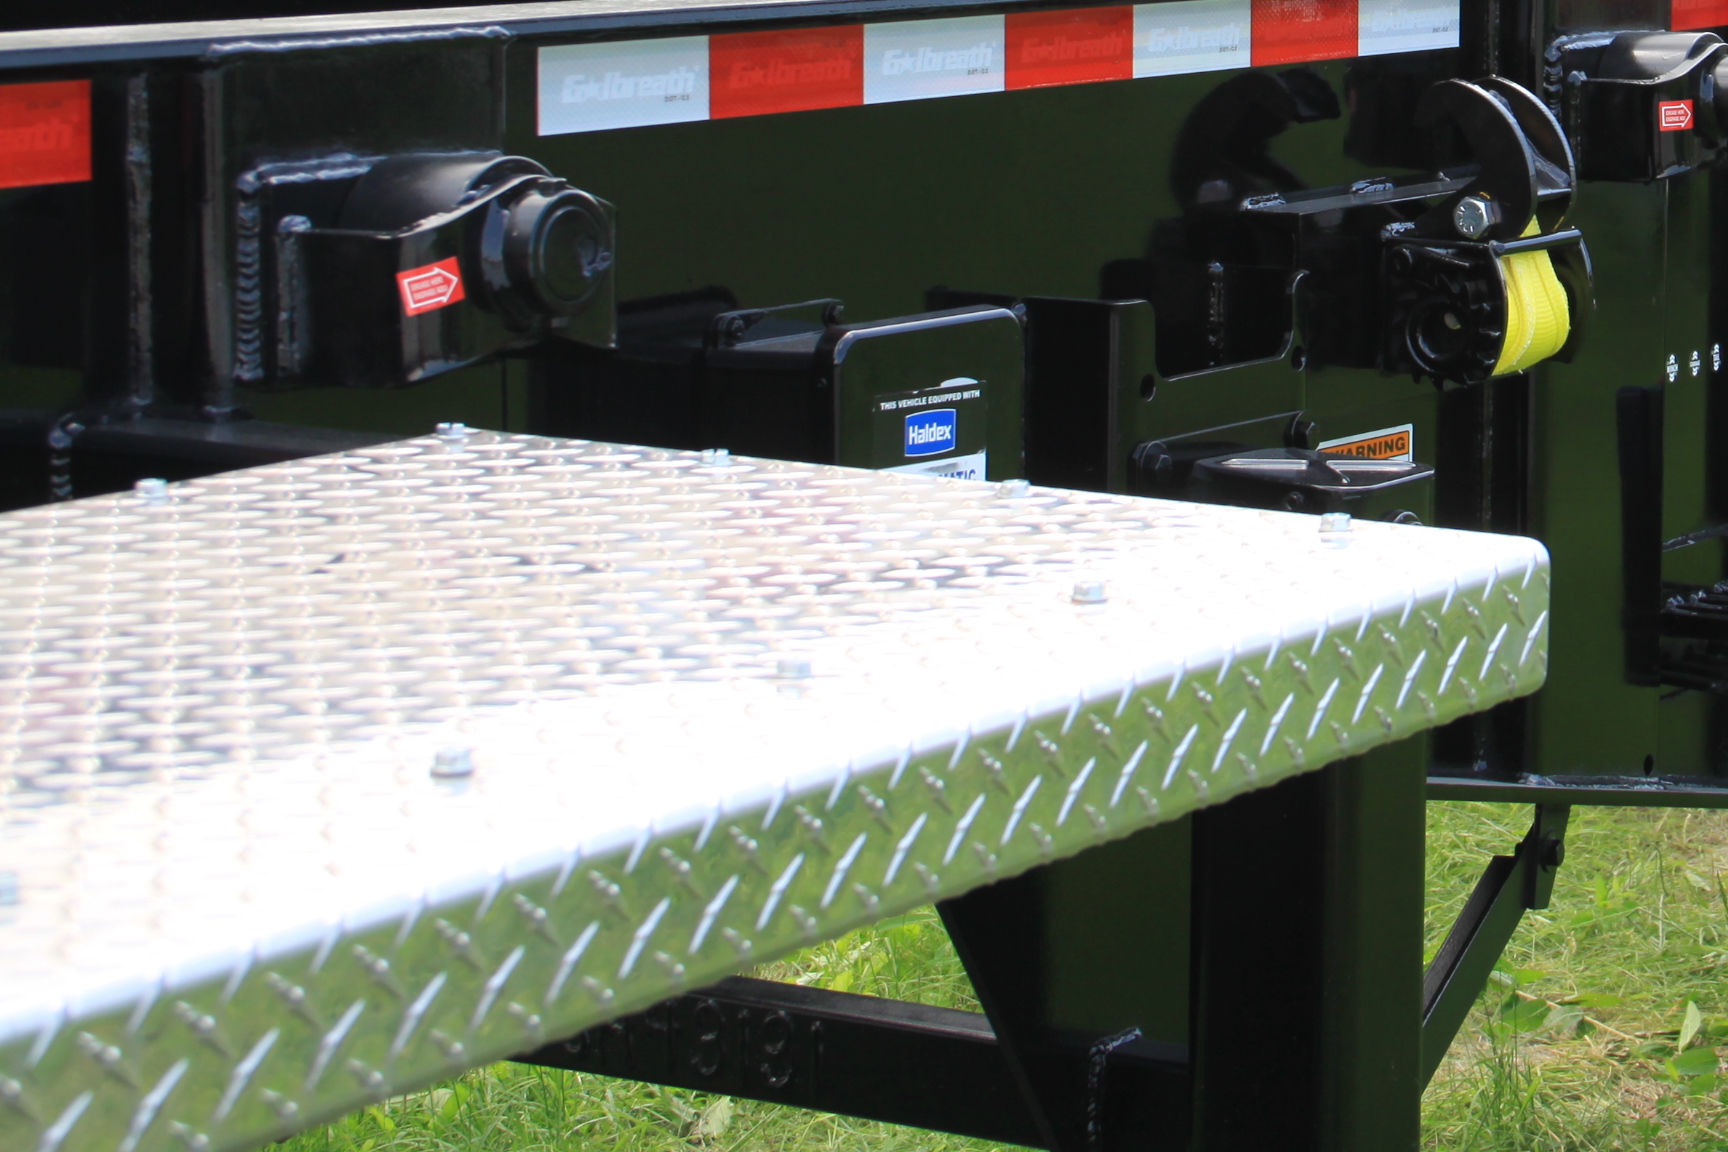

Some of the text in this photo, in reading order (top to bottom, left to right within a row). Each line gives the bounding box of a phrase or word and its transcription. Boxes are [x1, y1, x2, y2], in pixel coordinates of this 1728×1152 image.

[880, 389, 980, 411] THIS VEHICLE EQUIPPED WITH
[908, 422, 952, 445] Haldex
[1334, 436, 1406, 458] RNING
